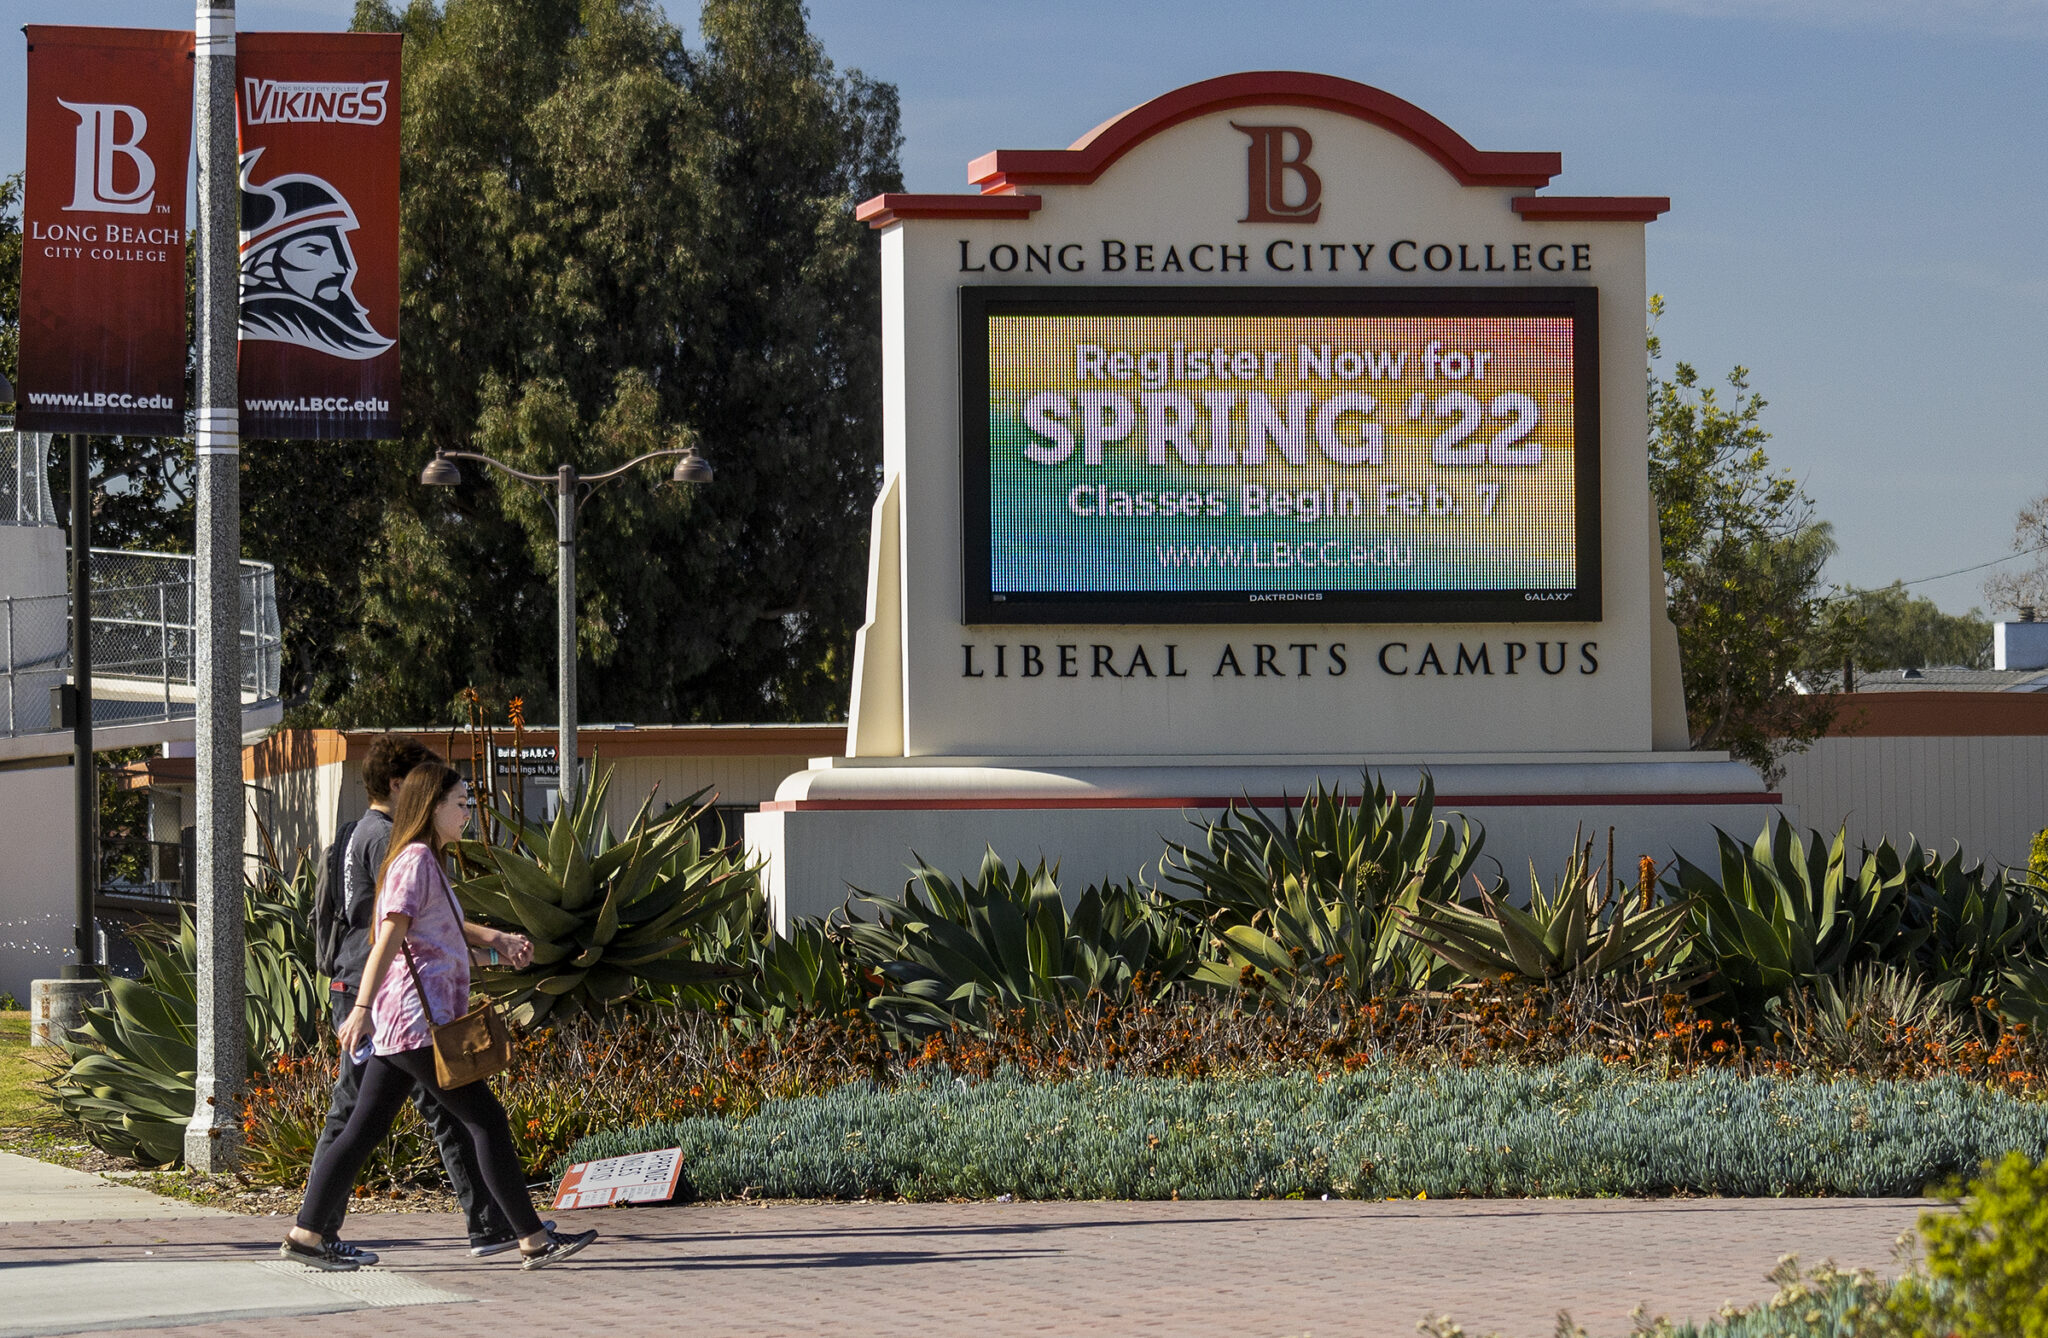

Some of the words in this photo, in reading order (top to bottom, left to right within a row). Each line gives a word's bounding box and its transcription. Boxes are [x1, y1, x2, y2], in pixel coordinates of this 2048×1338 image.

[246, 78, 388, 124] VIKINGS
[57, 96, 156, 214] LB
[1229, 120, 1322, 224] LB
[32, 221, 97, 242] LONG
[106, 224, 180, 245] BEACH
[44, 246, 83, 259] CITY
[91, 248, 166, 262] COLLEGE
[958, 239, 1086, 273] LONG
[1100, 239, 1250, 273] BEACH
[1265, 239, 1376, 273] CITY
[1387, 239, 1592, 273] COLLEGE
[1075, 341, 1282, 388] Register
[1297, 344, 1409, 380] Now
[1422, 339, 1492, 380] for
[28, 392, 173, 410] www.LBCC.edu
[245, 397, 389, 412] www.LBCC.edu
[1021, 390, 1385, 467] SPRING
[1067, 482, 1227, 518] Classes
[1241, 483, 1362, 523] Begin
[1378, 483, 1464, 517] Feb.
[1475, 483, 1501, 516] 7
[1156, 539, 1413, 569] www.LBCC.edu
[1249, 593, 1323, 602] DAKTRONICS
[962, 642, 1188, 680] LIBERAL
[1212, 642, 1348, 678] ARTS
[1378, 641, 1600, 678] CAMPUS
[497, 747, 529, 760] Buidgs
